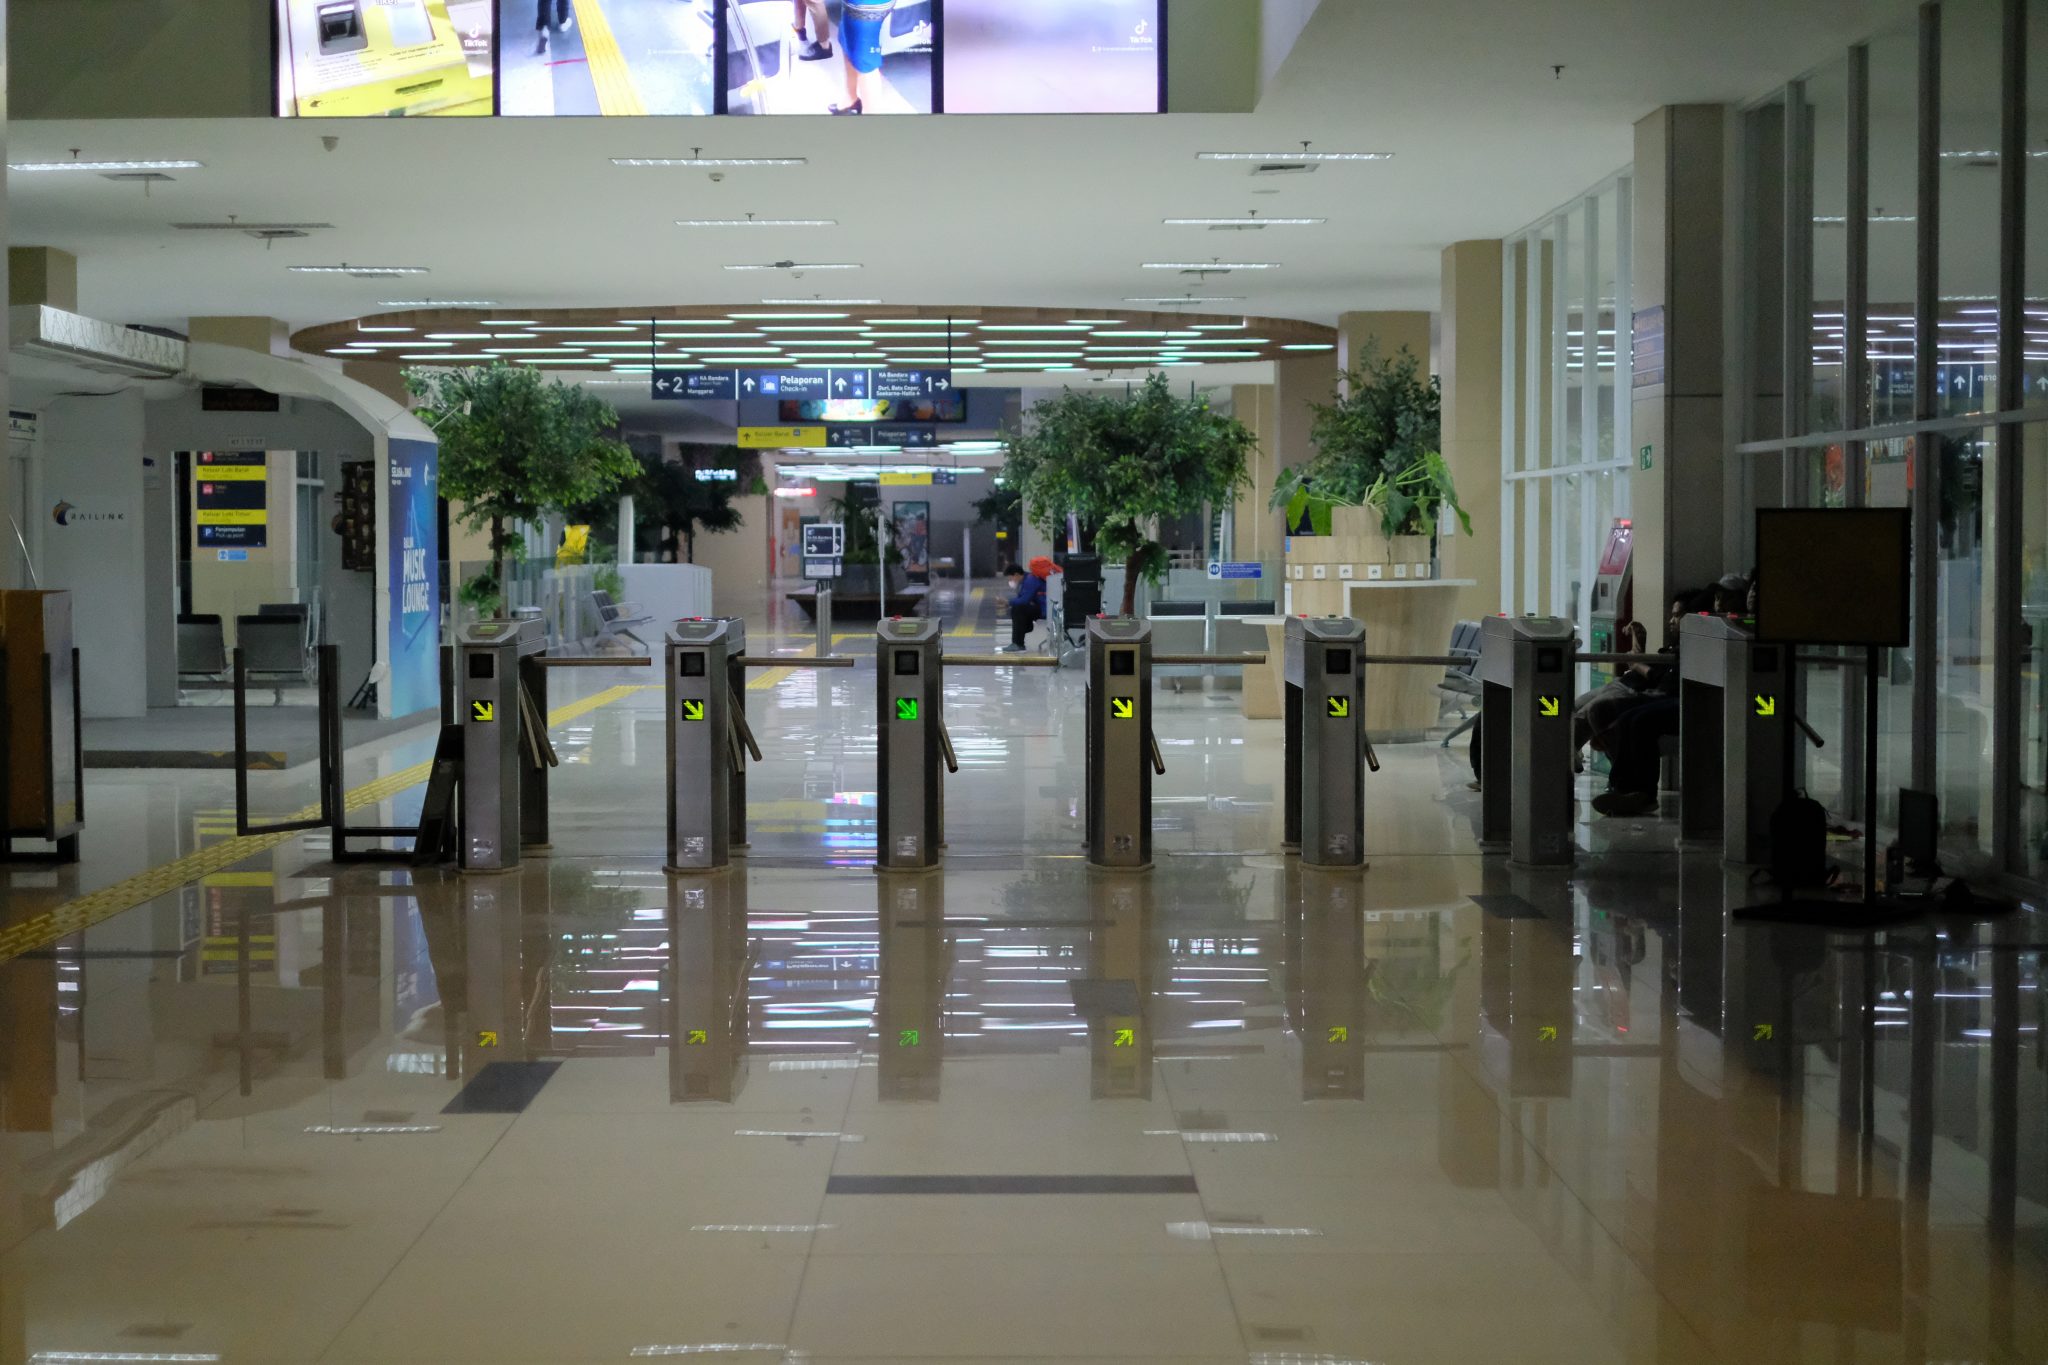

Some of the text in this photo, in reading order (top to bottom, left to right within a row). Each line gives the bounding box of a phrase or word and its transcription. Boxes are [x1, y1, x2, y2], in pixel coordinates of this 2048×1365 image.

[673, 376, 683, 393] 2
[780, 375, 823, 386] Pelaporan
[925, 376, 933, 393] 1
[403, 548, 426, 583] MUSIC
[403, 582, 429, 613] LOUNGE
